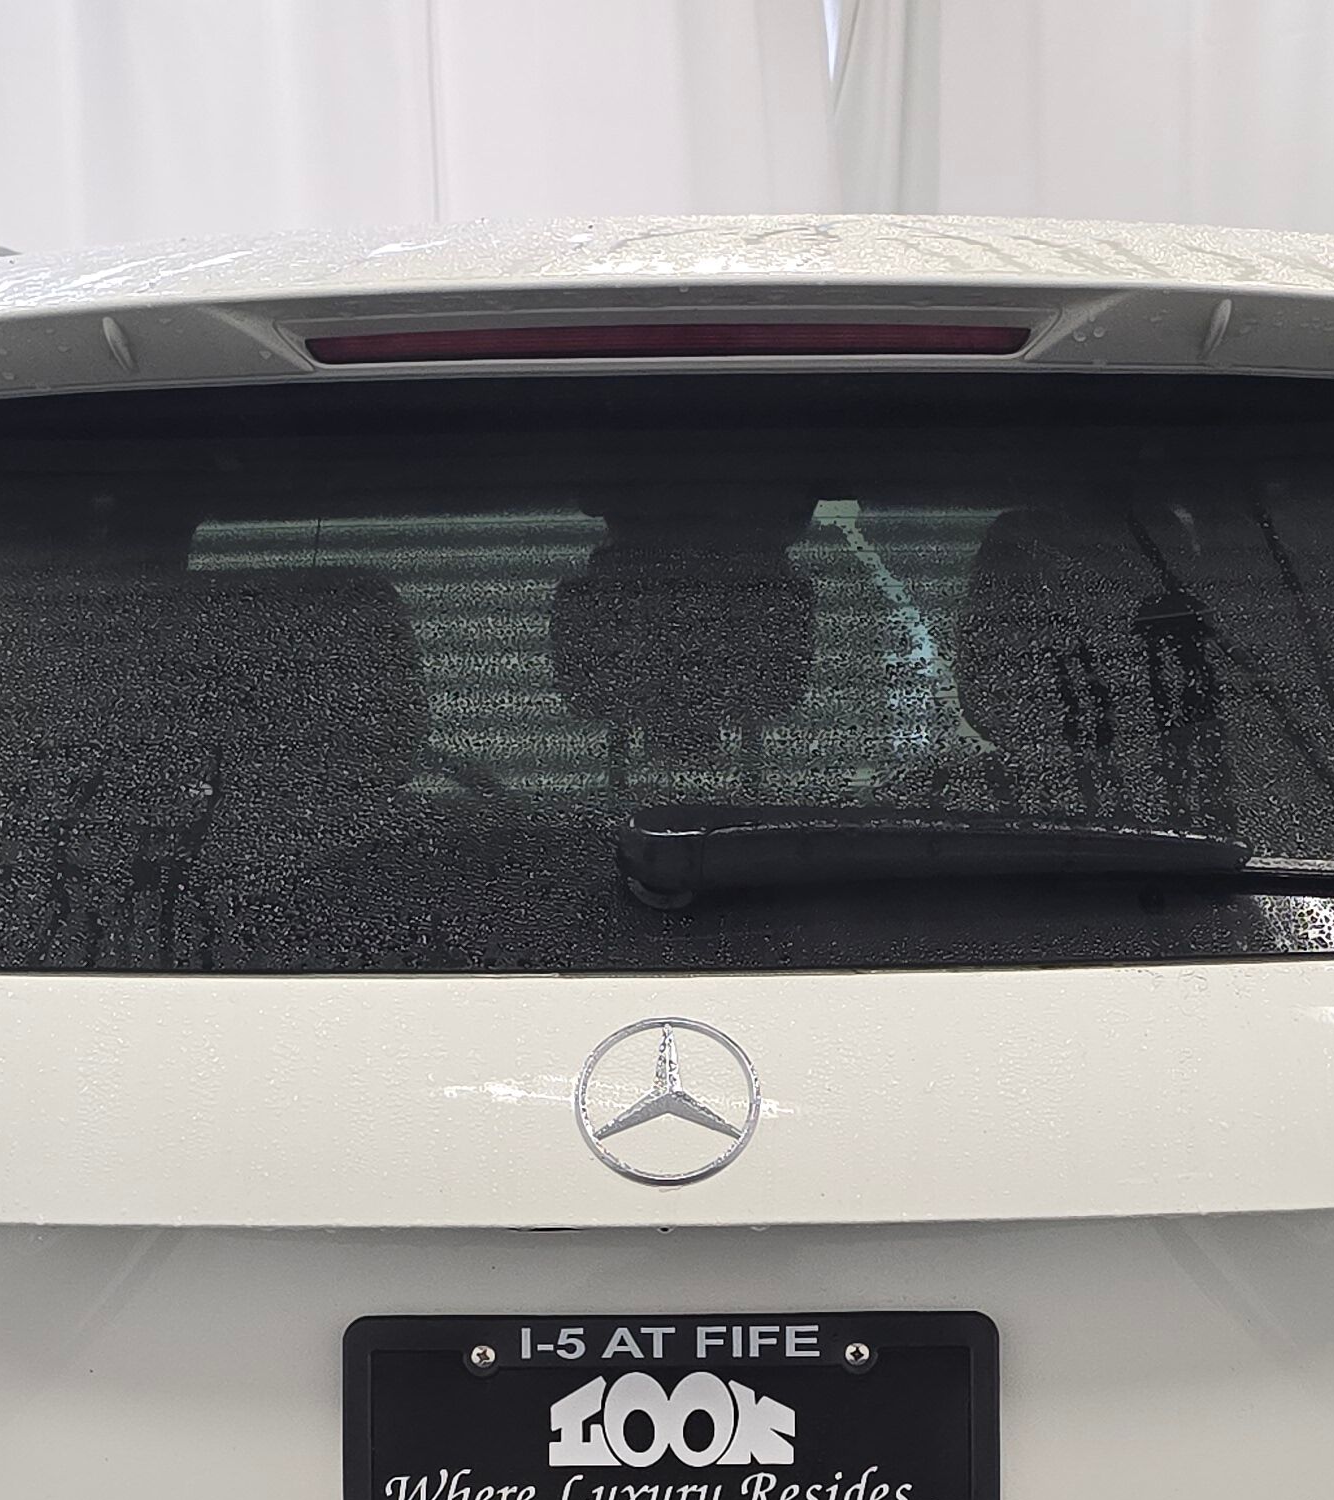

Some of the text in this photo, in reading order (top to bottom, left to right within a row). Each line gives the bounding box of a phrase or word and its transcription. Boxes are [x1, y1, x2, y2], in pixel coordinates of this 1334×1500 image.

[521, 1325, 821, 1359] I-5 AT FIFE
[549, 1371, 796, 1467] LOOK
